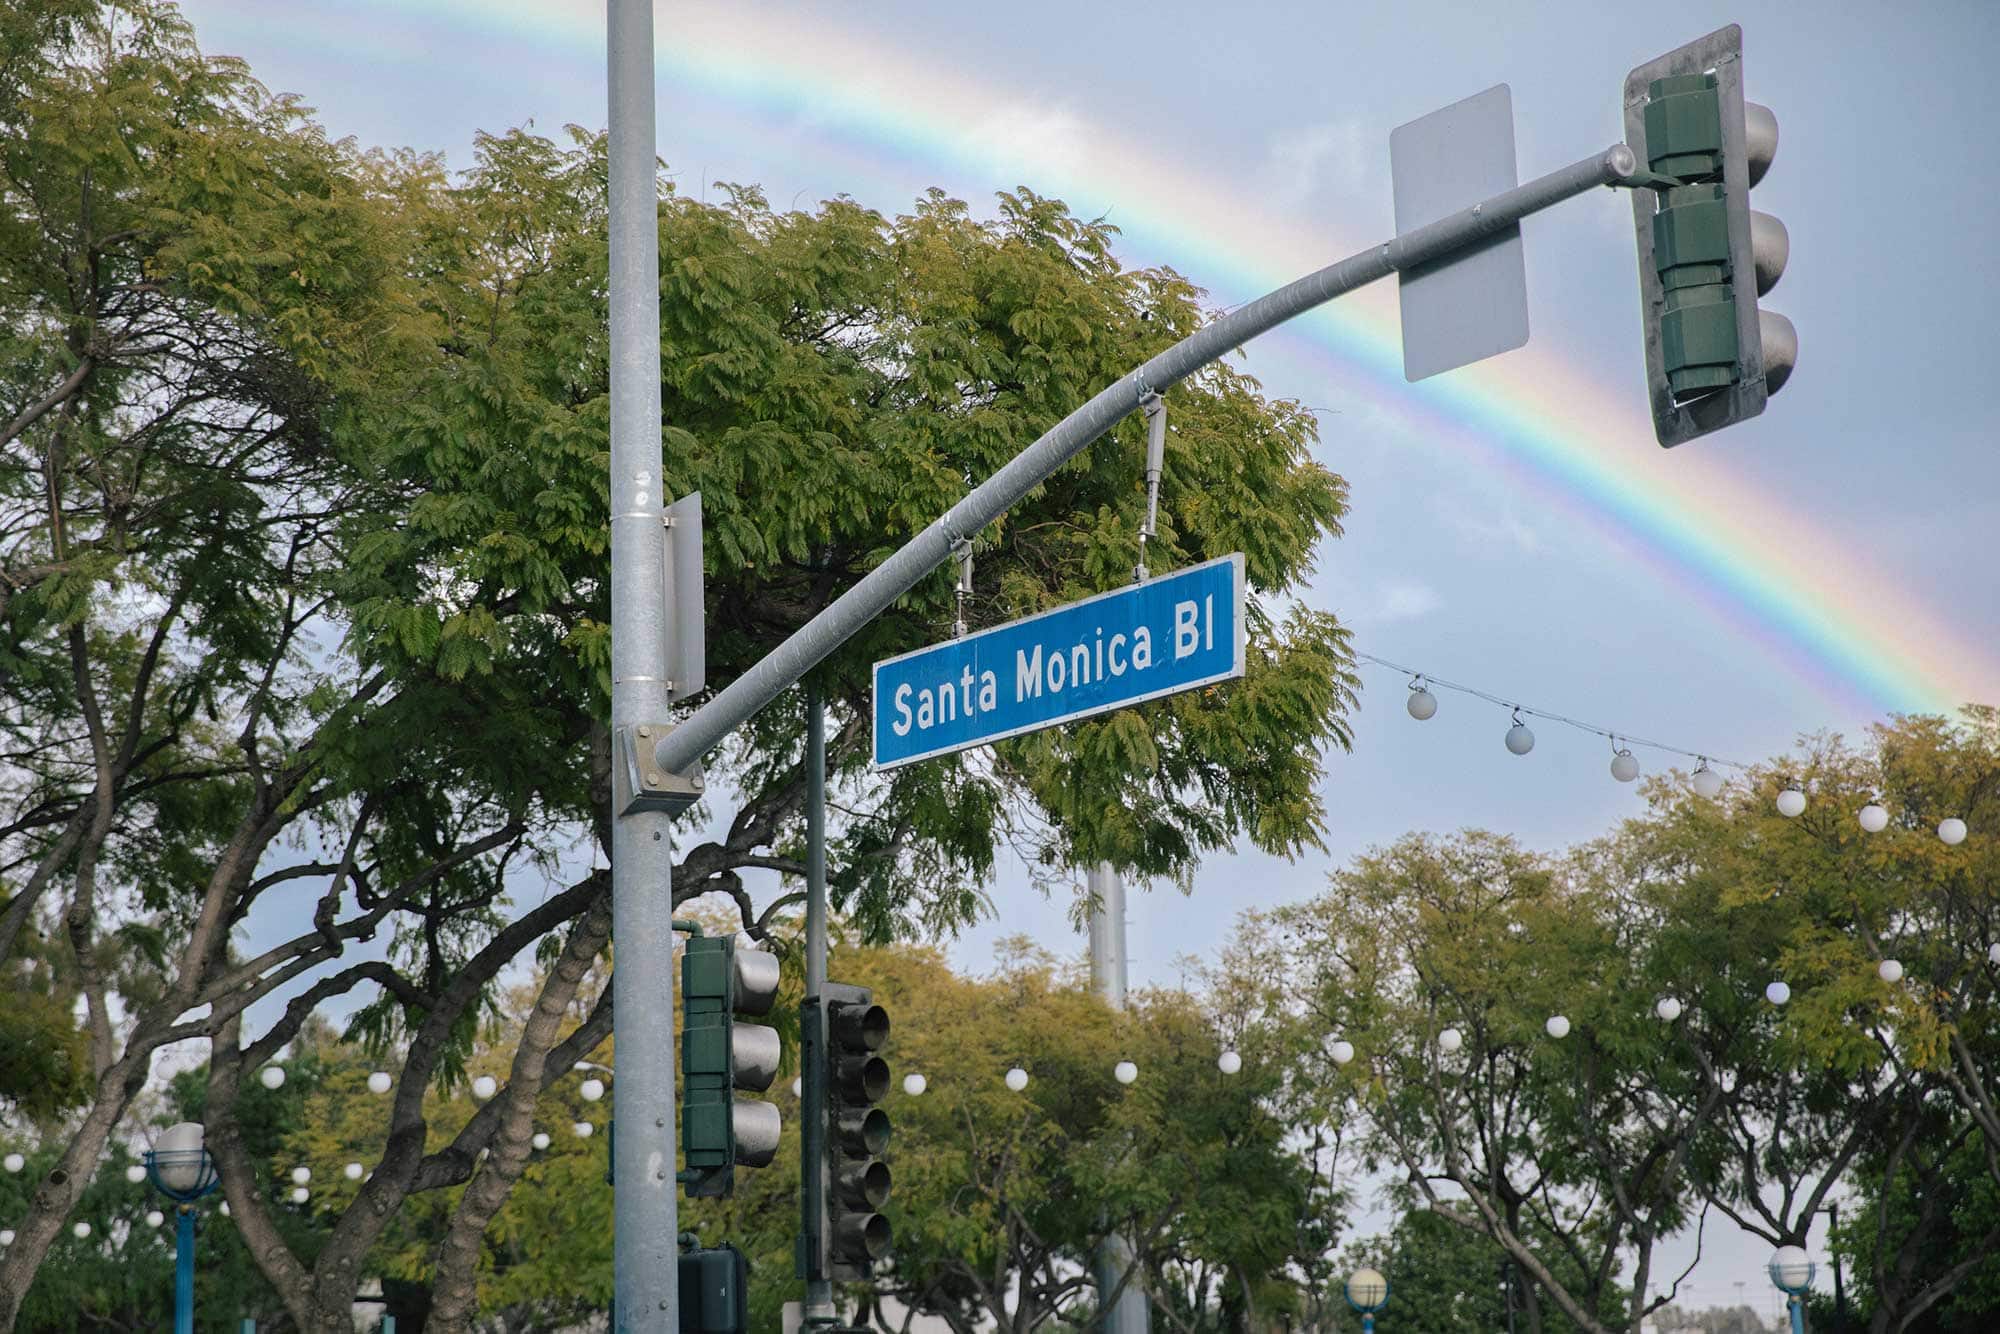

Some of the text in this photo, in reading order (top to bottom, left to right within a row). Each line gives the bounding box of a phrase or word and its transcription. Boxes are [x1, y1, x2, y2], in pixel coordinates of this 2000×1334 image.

[892, 594, 1213, 736] Santa Monica Bl
